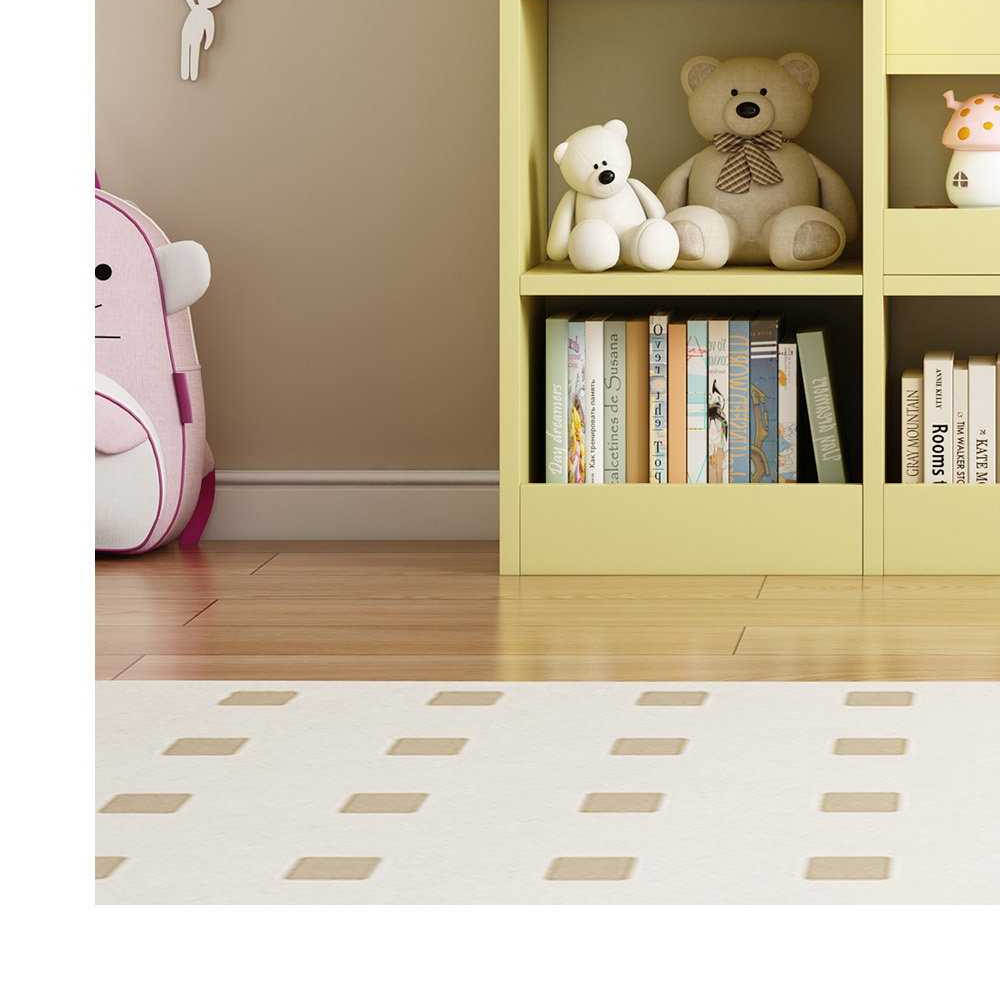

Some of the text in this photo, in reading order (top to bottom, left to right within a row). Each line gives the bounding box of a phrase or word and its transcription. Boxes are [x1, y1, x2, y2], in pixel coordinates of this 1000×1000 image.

[603, 334, 621, 392] Susana
[604, 395, 619, 413] de
[546, 384, 564, 475] Day dreamers
[906, 390, 920, 477] GRAY MOUNTAIN
[956, 421, 965, 435] TIM
[932, 424, 948, 476] Rooms
[956, 437, 965, 469] WALKER
[976, 439, 988, 469] KATE
